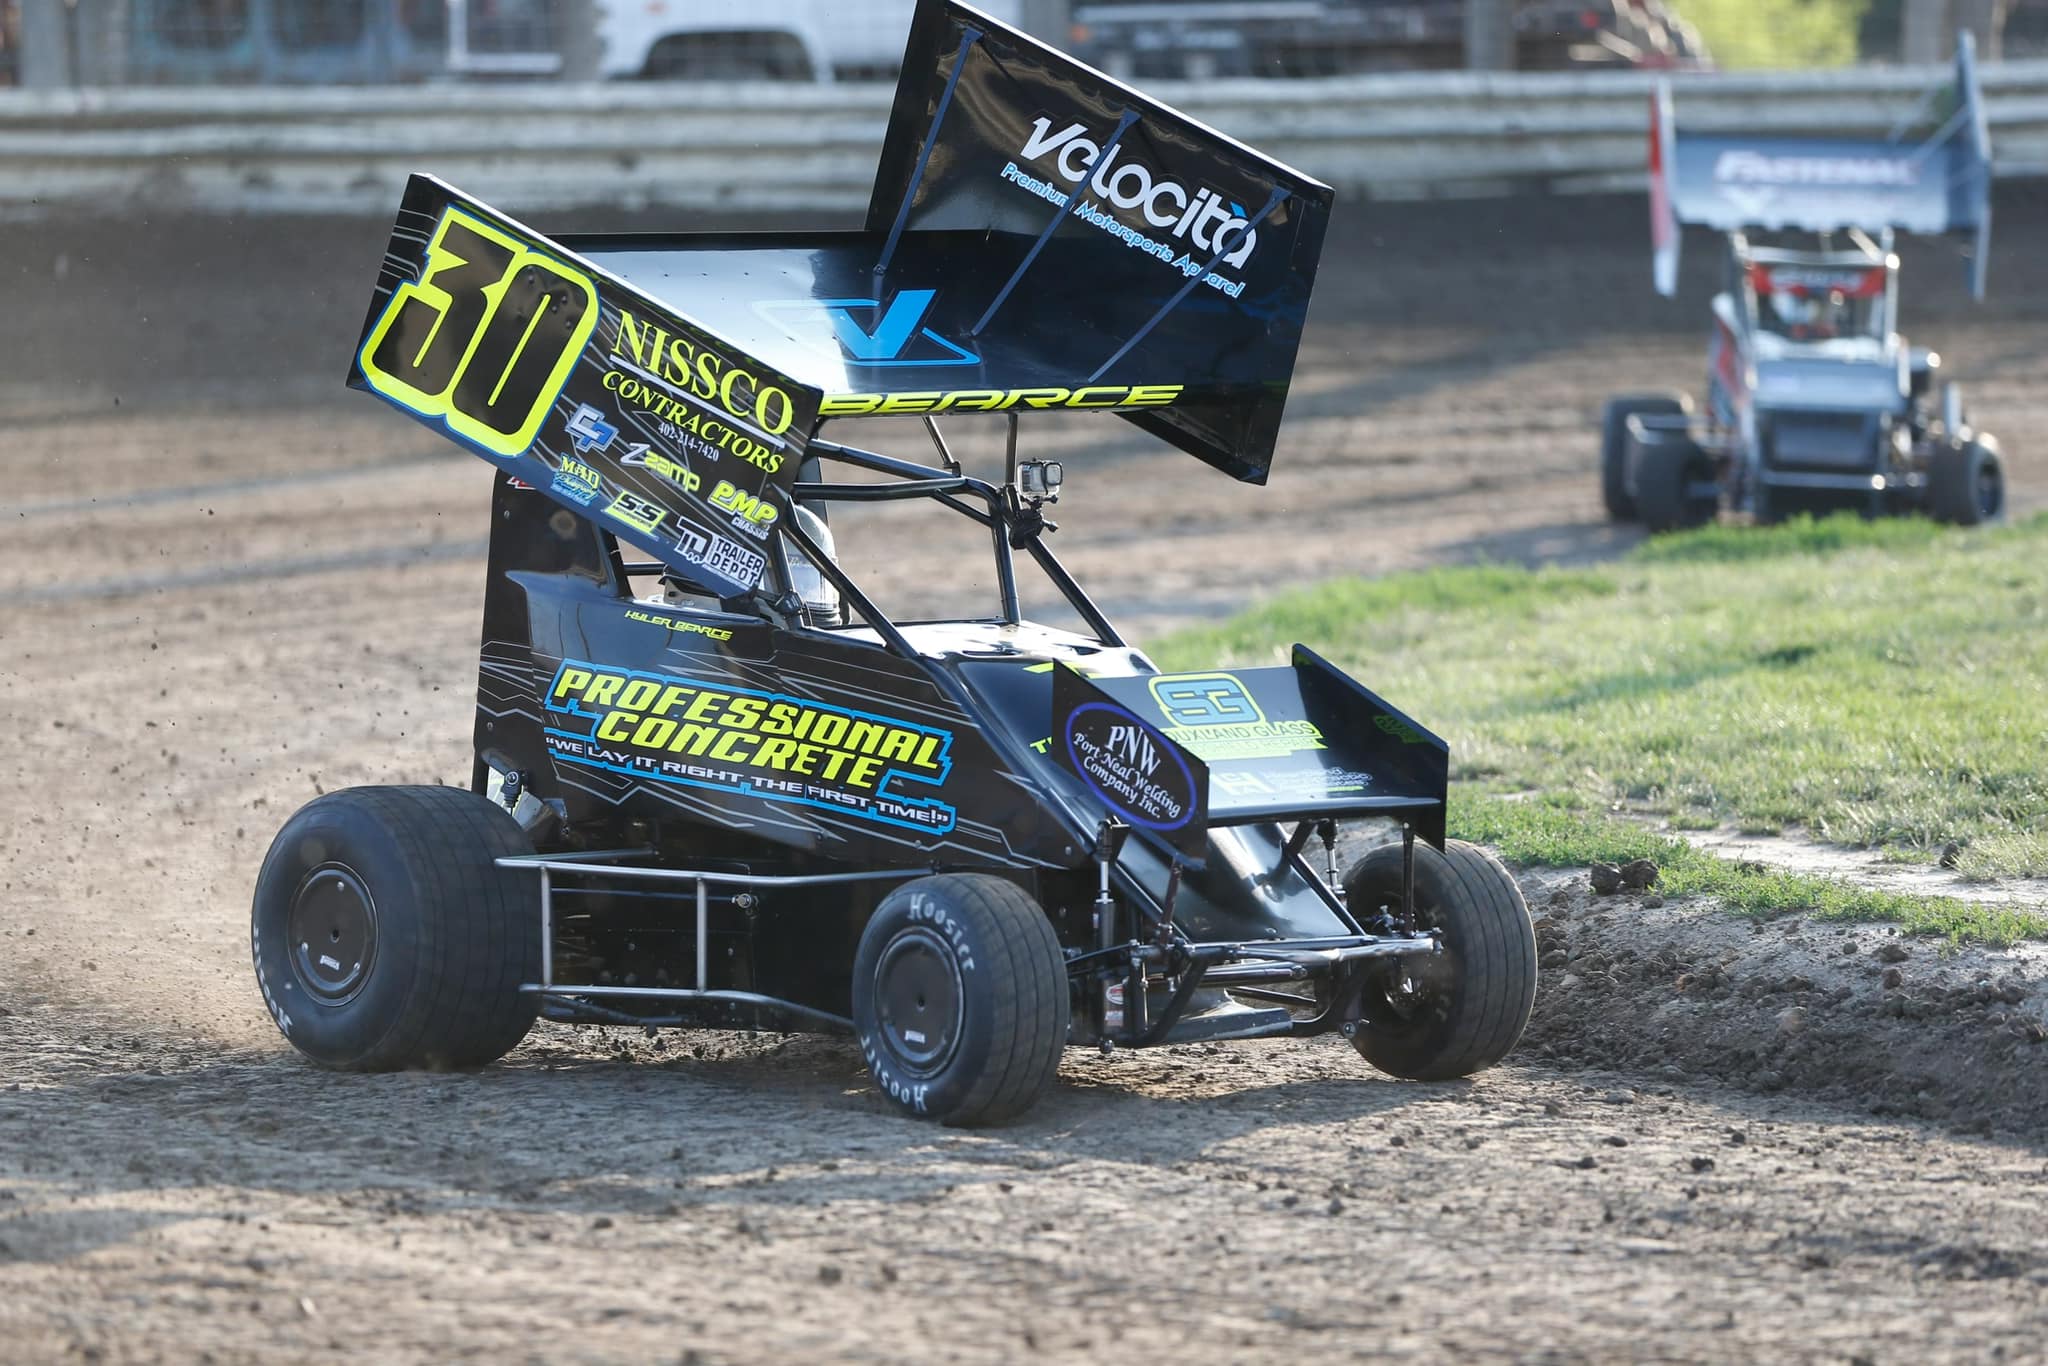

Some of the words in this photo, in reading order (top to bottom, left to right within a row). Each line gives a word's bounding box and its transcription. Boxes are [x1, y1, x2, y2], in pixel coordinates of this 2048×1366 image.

[1000, 161, 1070, 208] Premium
[1073, 199, 1174, 263] Motorsports
[1171, 252, 1247, 299] Aparel
[1019, 116, 1258, 271] Velocità
[359, 205, 600, 457] 30
[610, 308, 794, 436] NISSCO
[818, 384, 1184, 415] BEARCE
[602, 370, 785, 474] CONTRACTORS
[657, 421, 720, 462] 402-214-7420
[709, 480, 779, 525] PMP
[731, 517, 770, 541] CHASSIS
[710, 554, 758, 586] DEPOT
[716, 538, 764, 573] TRAILER
[674, 621, 733, 641] BEARCE
[553, 667, 944, 770] PROFESSIONAL
[597, 709, 885, 789] CONCRETE
[1105, 726, 1161, 777] PNW
[1253, 720, 1319, 738] GLASS
[545, 736, 584, 756] “WE
[588, 747, 629, 764] LAY
[634, 754, 658, 770] IT
[662, 761, 740, 784] RIGHT
[750, 775, 803, 794] THE
[807, 784, 870, 808] FIRST
[875, 799, 951, 826] TIME!”
[1073, 732, 1100, 759] Port
[1101, 752, 1135, 780] Neal
[1134, 770, 1182, 818] Welding
[1083, 755, 1138, 804] Company
[1138, 794, 1161, 819] Inc.
[907, 892, 976, 972] Hoosier
[860, 1034, 929, 1113] Hoosier
